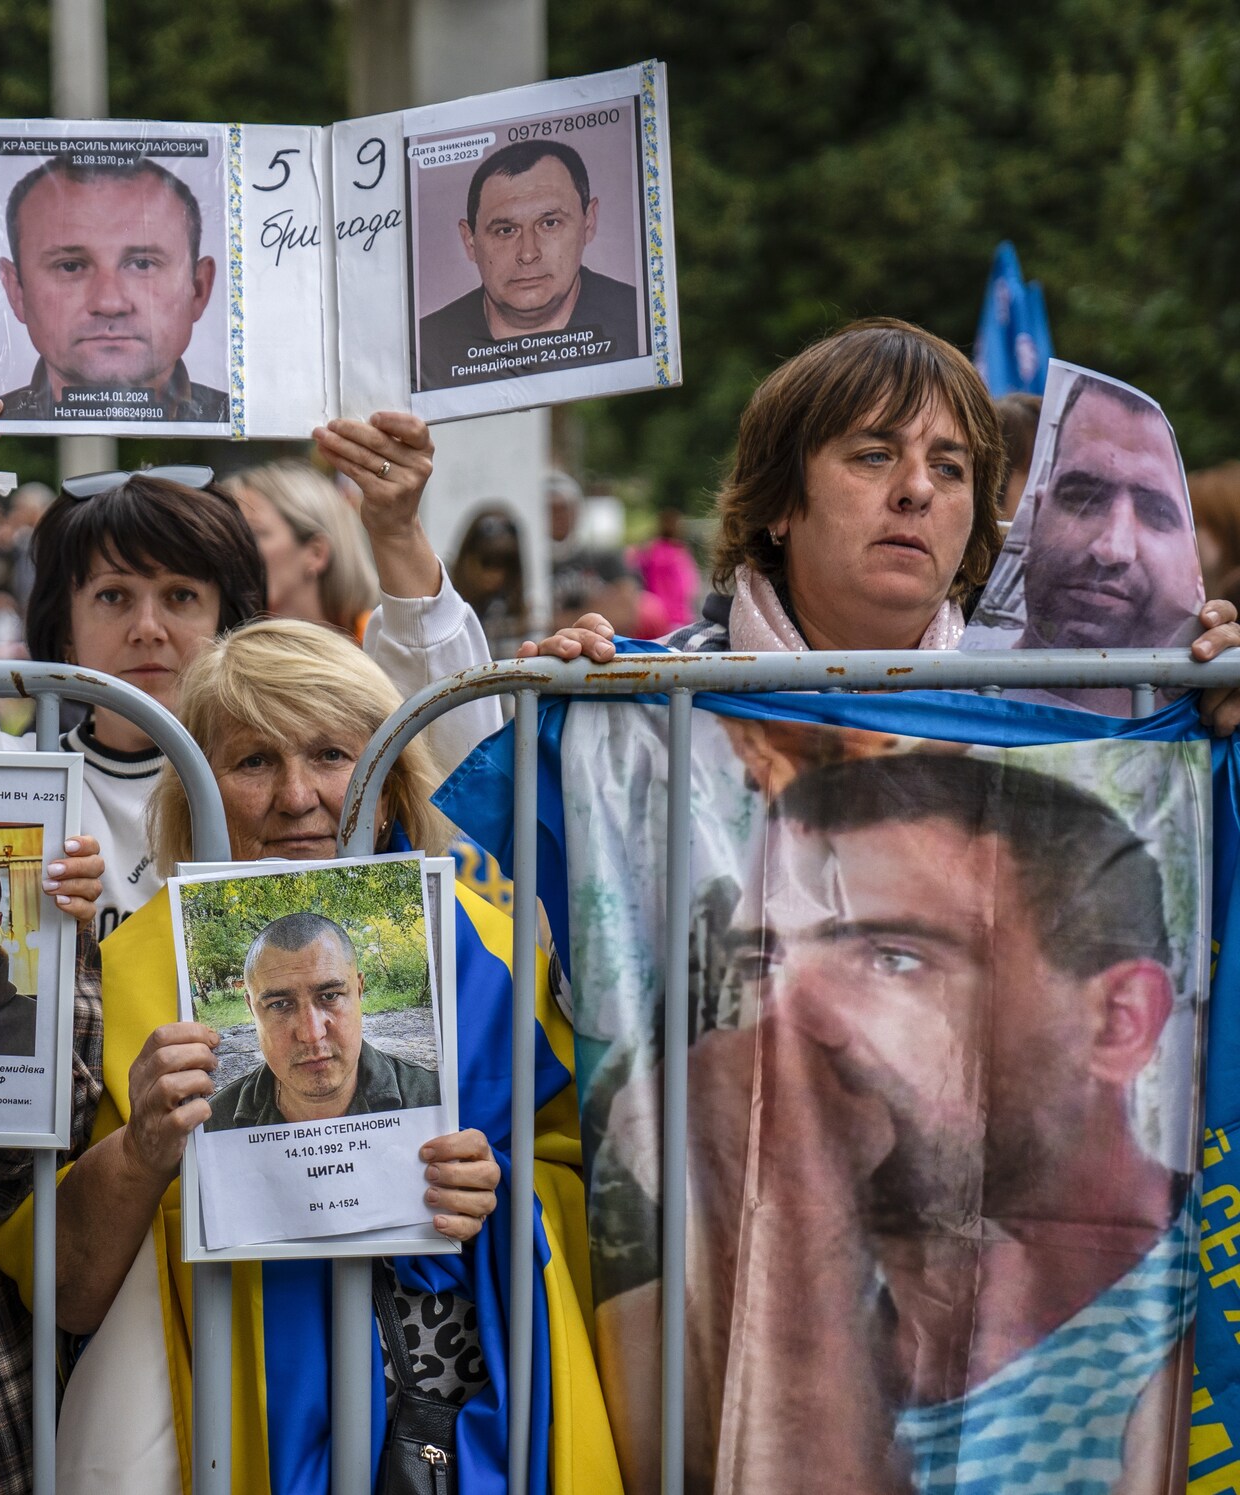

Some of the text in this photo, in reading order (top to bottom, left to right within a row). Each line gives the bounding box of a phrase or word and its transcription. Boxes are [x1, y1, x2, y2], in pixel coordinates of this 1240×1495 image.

[508, 108, 620, 142] 0978780800
[3, 140, 203, 153] КРАВЕЦЬ ВАСИЛЬ МИКОЛАЙОВИЧ
[412, 136, 490, 158] Дата зникнення
[72, 155, 116, 165] 13.09.1970
[423, 148, 479, 167] 09.03.2023
[467, 330, 594, 359] Олексін Олександр
[451, 341, 612, 377] Геннадійович 24.08.1977
[14, 792, 28, 801] ВЧ
[33, 792, 66, 802] А-2215
[248, 1117, 401, 1144] ШУПЕР ІВАН СТЕПАНОВИЧ
[285, 1140, 371, 1159] 14.10.1992 Р.Н.
[307, 1163, 354, 1179] ЦИГАН
[310, 1198, 359, 1212] ВЧ А-1524
